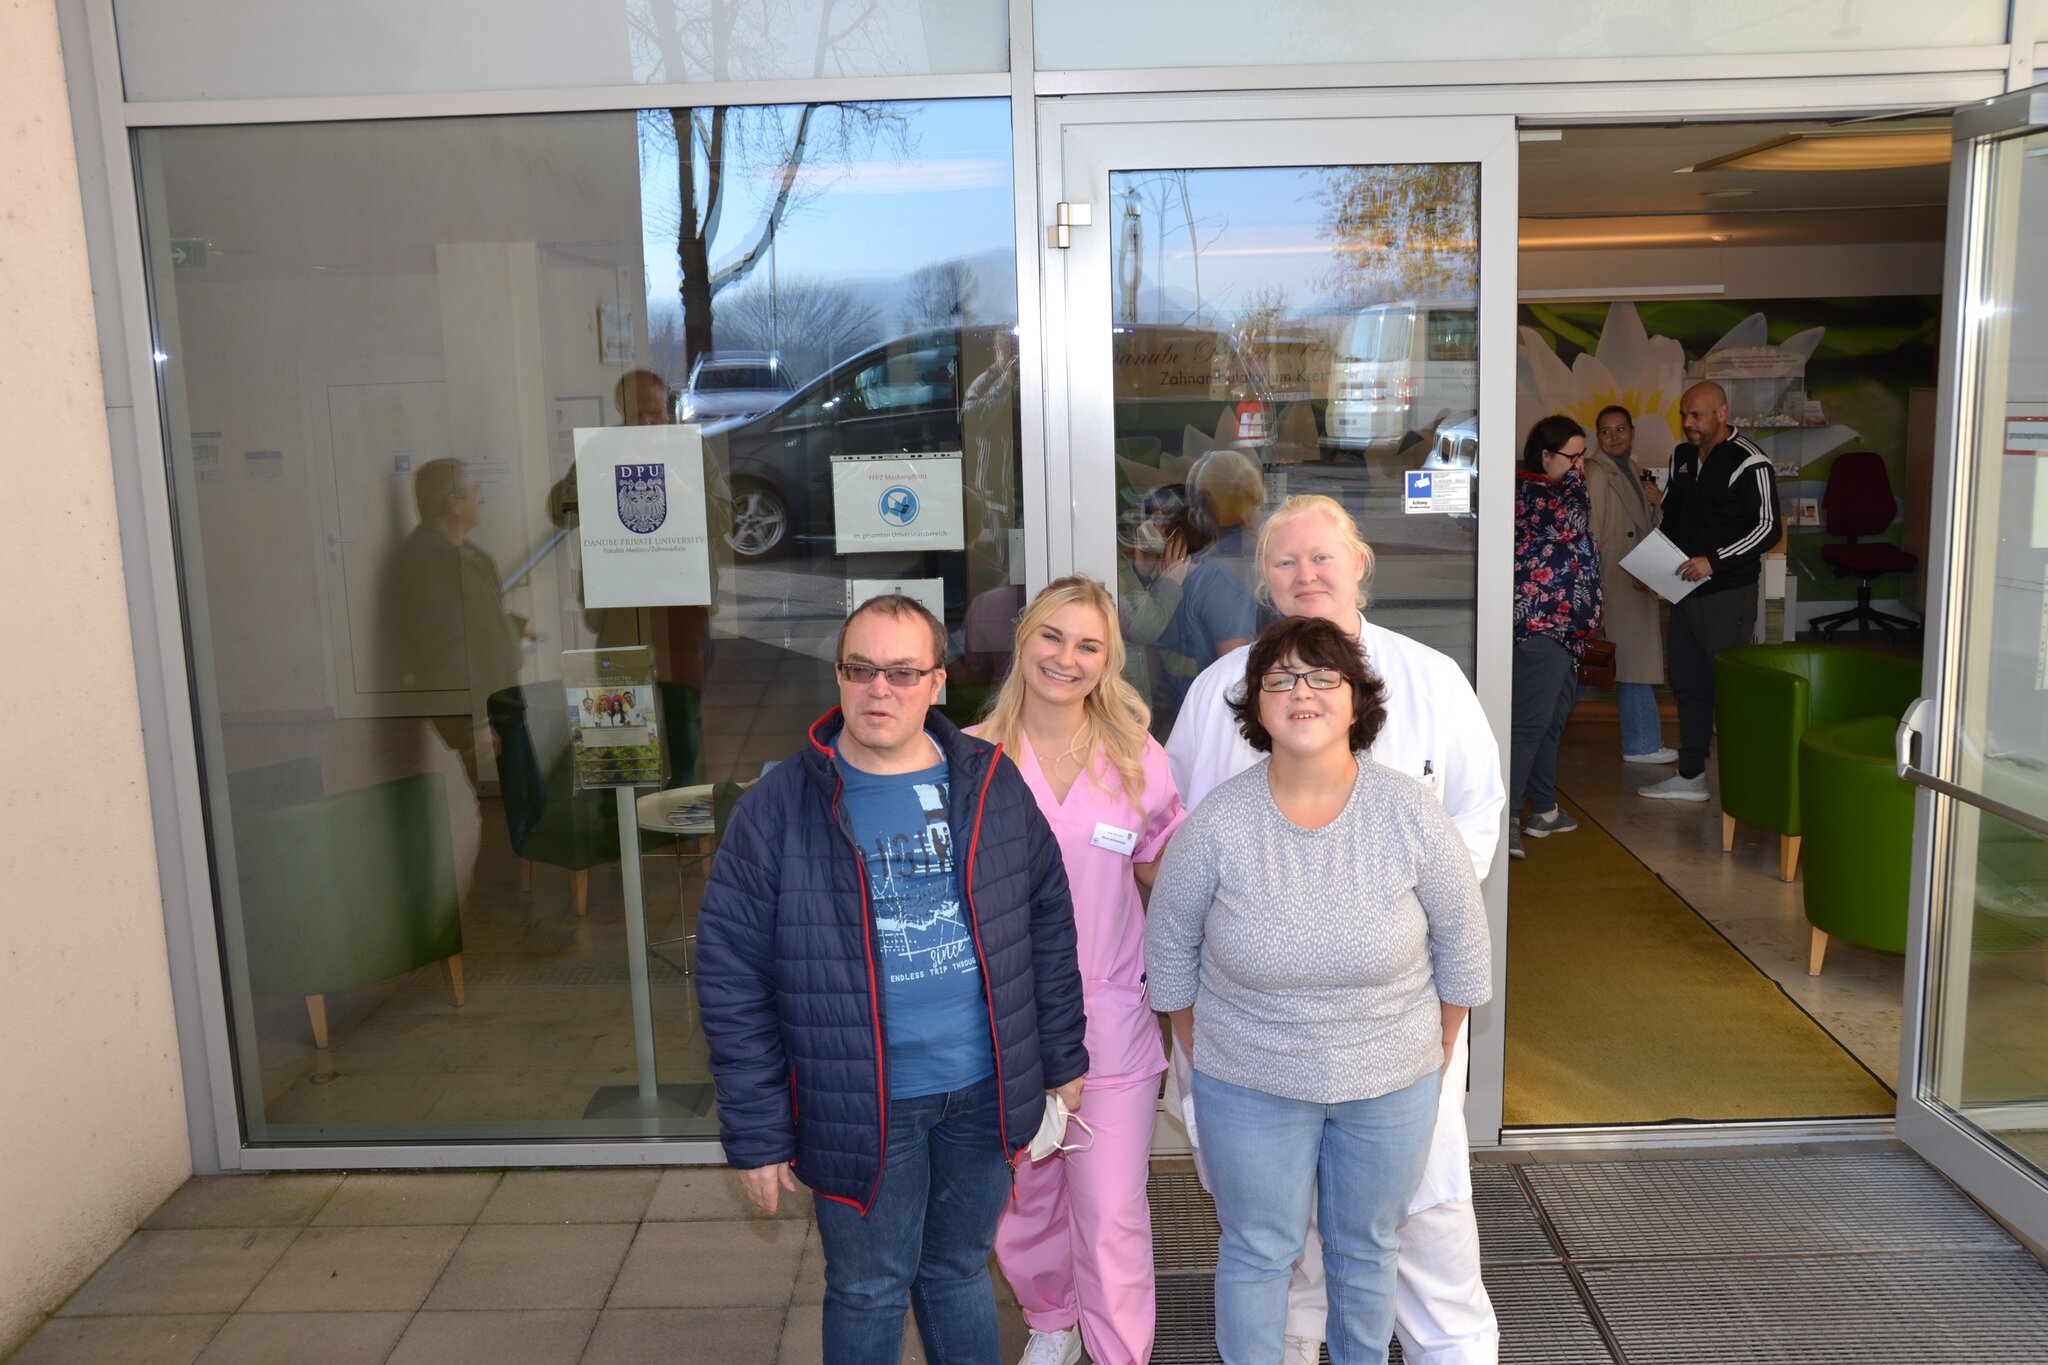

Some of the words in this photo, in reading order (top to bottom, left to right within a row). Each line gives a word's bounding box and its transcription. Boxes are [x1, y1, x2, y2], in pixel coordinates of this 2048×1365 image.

[621, 465, 660, 478] DPU
[884, 472, 928, 481] Maskenpflcht
[862, 531, 890, 540] gesamten
[583, 539, 618, 547] DANUBE
[620, 537, 653, 546] PRIVATE
[655, 536, 705, 545] UNIVERSITY
[890, 970, 925, 983] ENDLESS
[930, 965, 948, 976] TRIP
